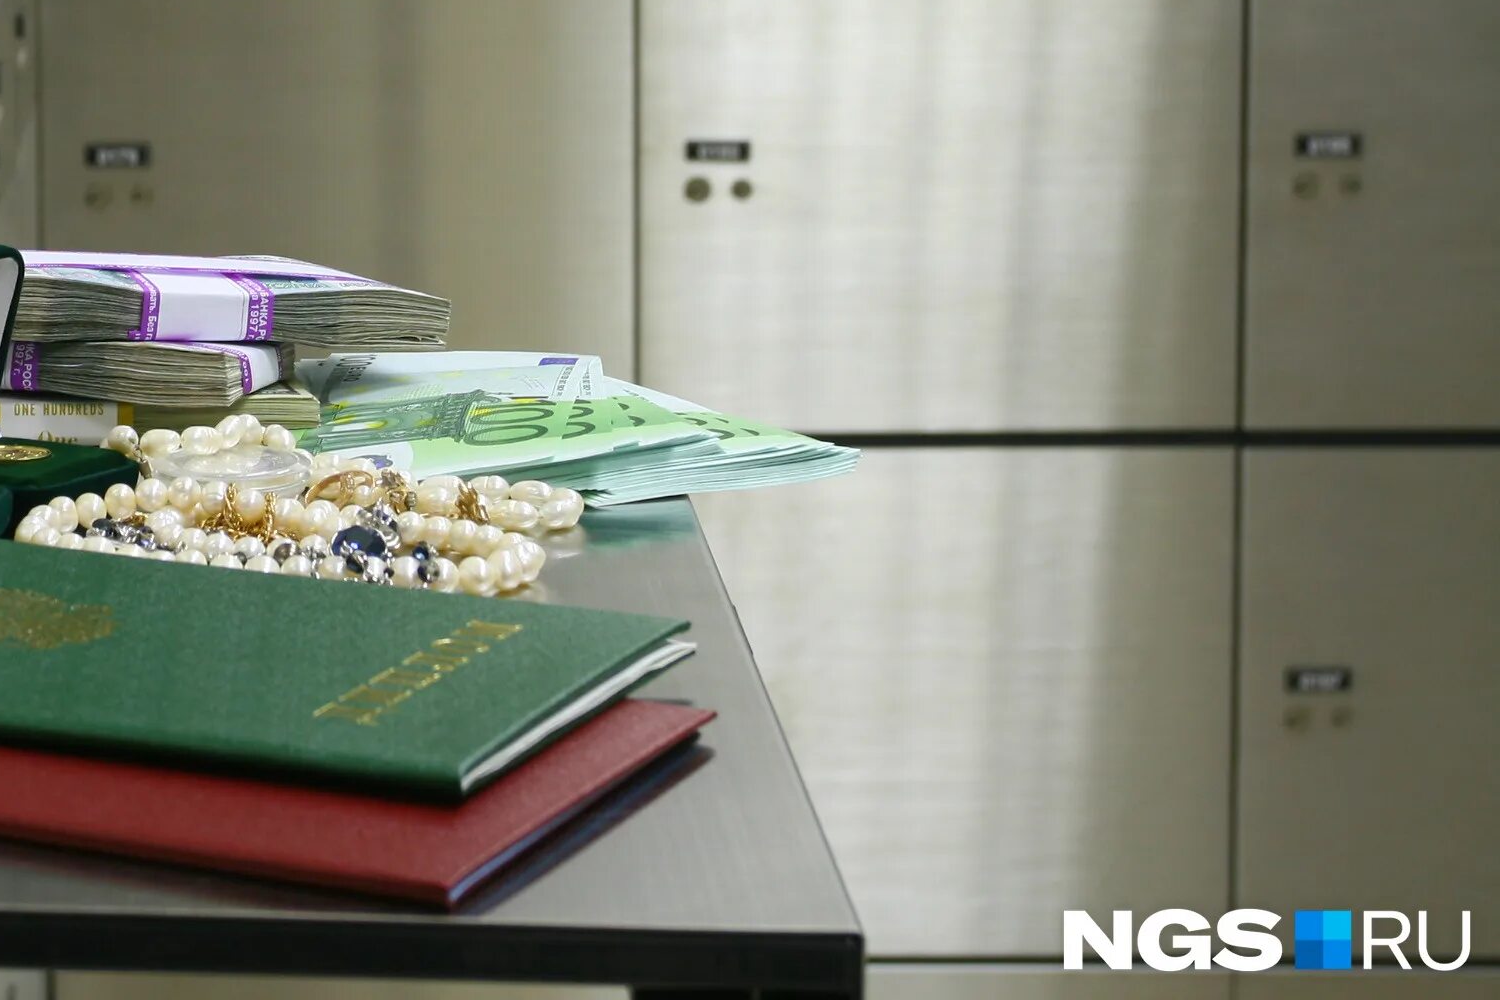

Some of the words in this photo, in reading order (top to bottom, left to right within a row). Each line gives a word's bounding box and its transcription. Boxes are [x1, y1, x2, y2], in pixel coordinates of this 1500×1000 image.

[249, 304, 260, 333] 1997
[14, 403, 36, 417] ONE
[43, 402, 105, 417] HUNDREDS
